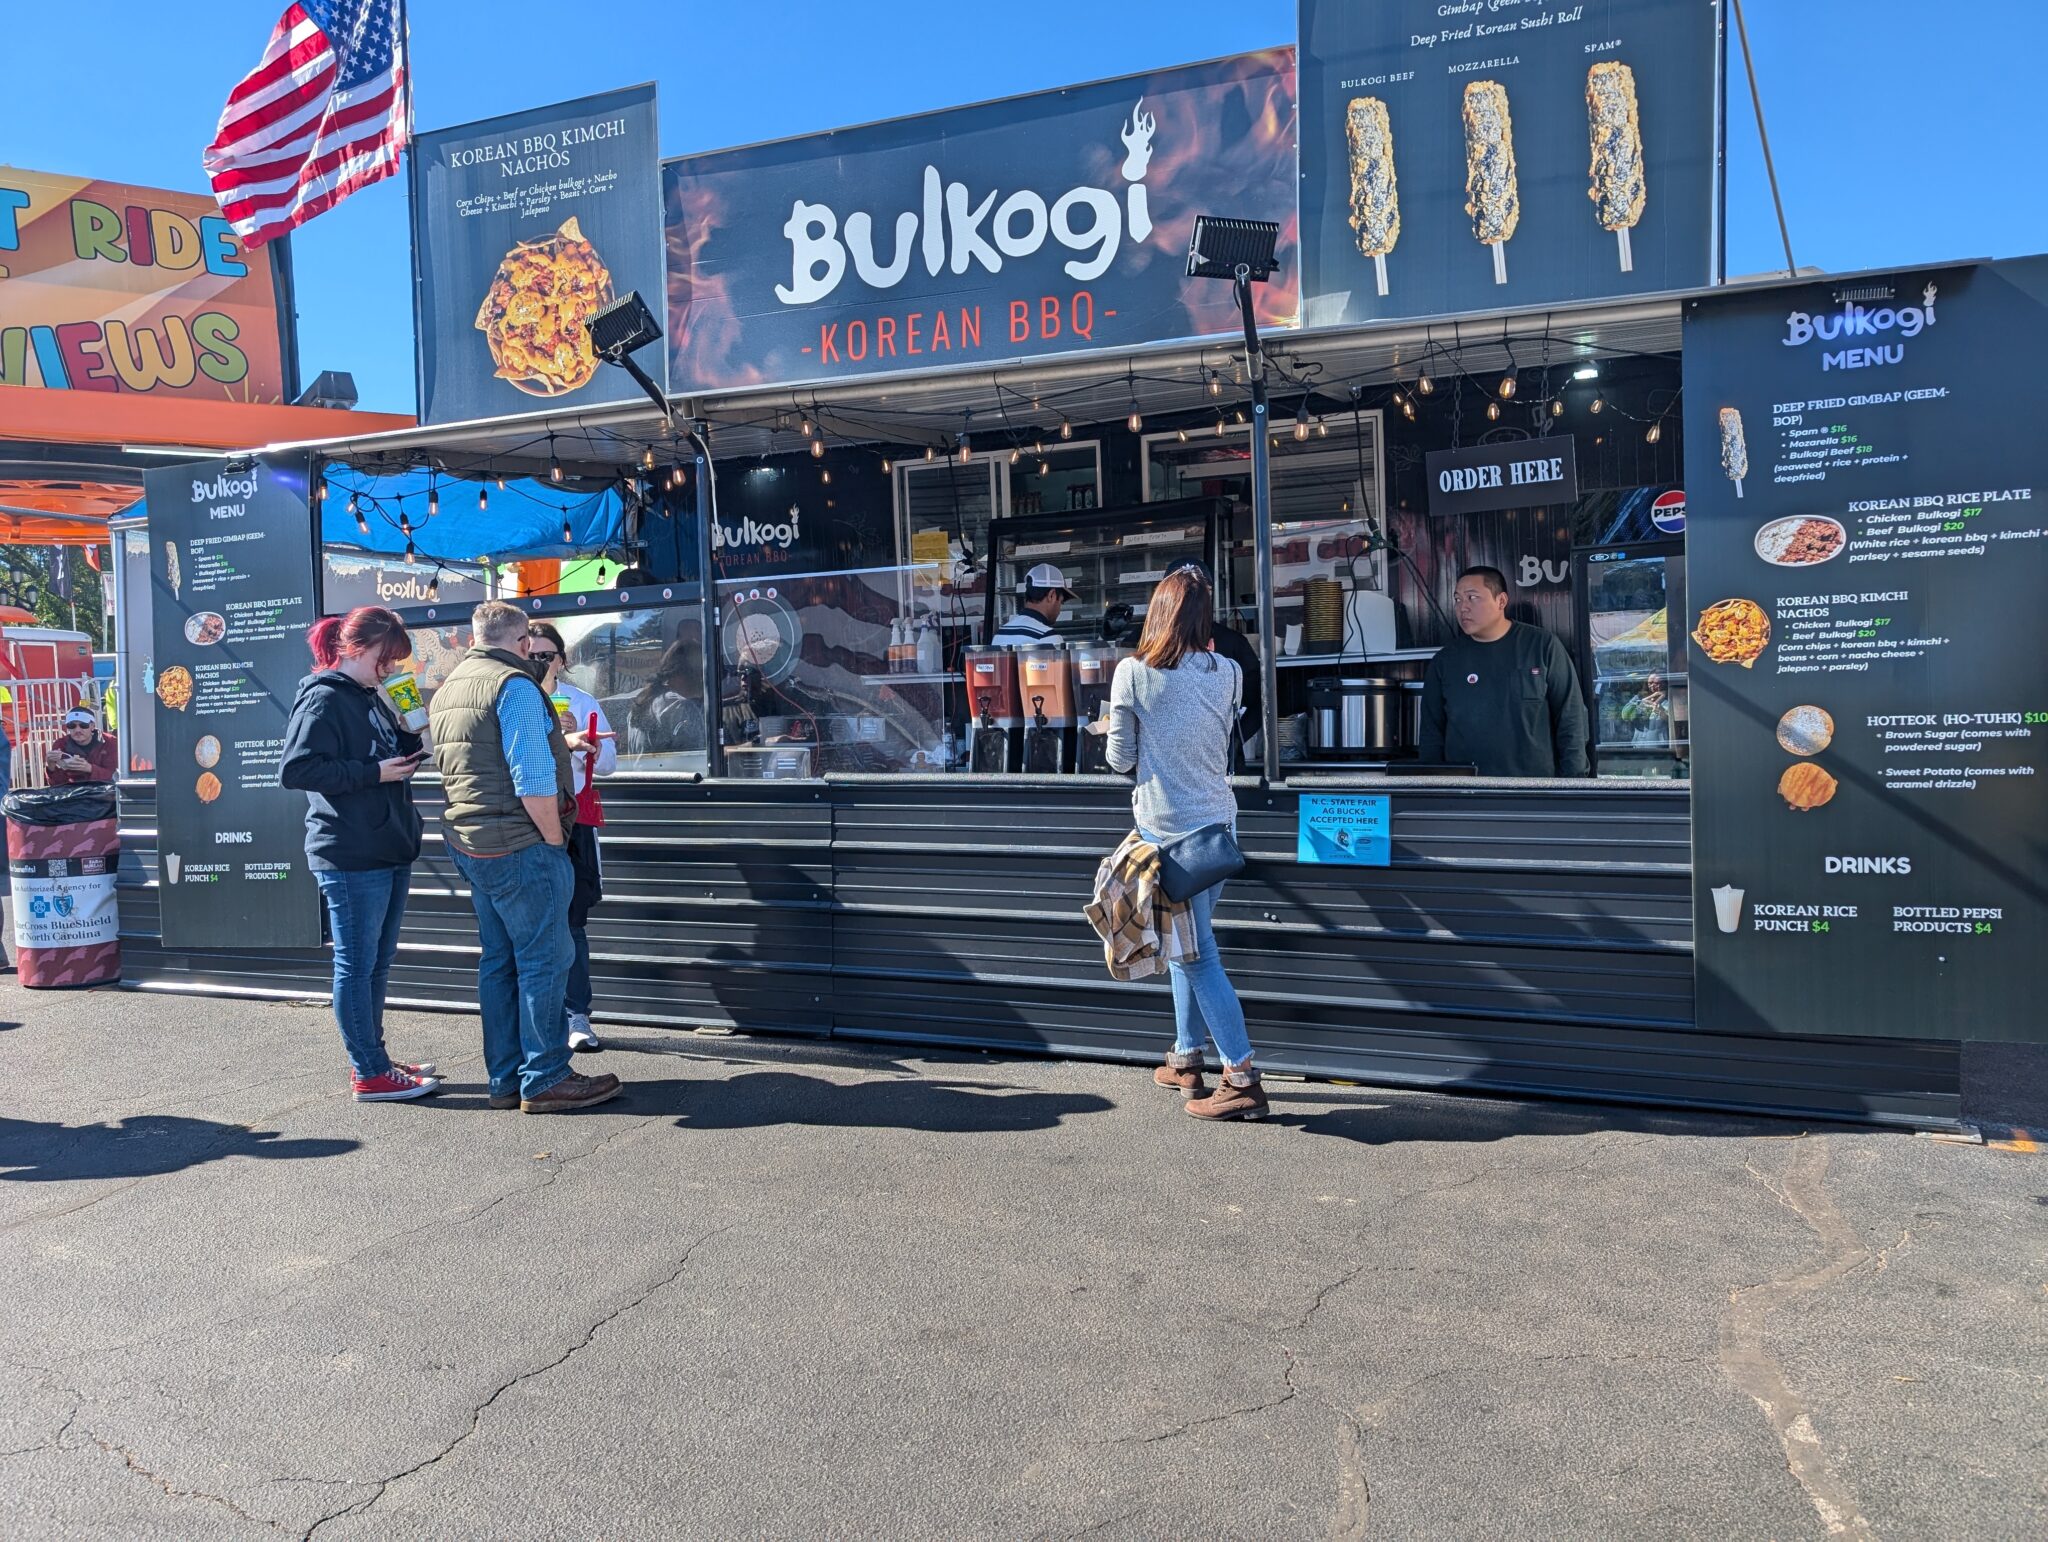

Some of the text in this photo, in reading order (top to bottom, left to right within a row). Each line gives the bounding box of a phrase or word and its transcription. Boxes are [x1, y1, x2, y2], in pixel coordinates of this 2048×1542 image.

[1437, 1, 1484, 17] Gimbap
[1410, 32, 1438, 49] Deep
[1440, 24, 1474, 42] Fried
[1475, 21, 1518, 37] Korean
[1520, 12, 1554, 30] Sushi
[1557, 5, 1584, 24] Roll
[1448, 56, 1520, 74] MOZZARELLA
[1341, 71, 1415, 89] BULKOGI BEEF
[451, 119, 626, 168] KOREAN BBQ KIMCHI
[501, 151, 571, 178] NACHOS
[455, 199, 473, 209] Corn
[474, 193, 495, 206] Chips
[503, 187, 519, 201] Beef
[519, 189, 527, 197] or
[528, 181, 557, 196] Chicken
[594, 169, 618, 183] Nacho
[460, 184, 607, 217] Cheese Kimchi Parsley Beans Corn
[773, 95, 1154, 305] Bulkogi
[70, 198, 249, 277] RIDE
[1782, 281, 1937, 347] Bulkogi
[1822, 343, 1905, 372] MENU
[1773, 387, 1951, 414] DEEP FRIED GIMBAP (GEEM-
[1773, 414, 1803, 427] BOP)
[1789, 424, 1848, 438] Spam $16
[1789, 435, 1858, 449] Mozarella $16
[1789, 445, 1873, 460] Bulkogi Beef $18
[1774, 454, 1900, 474] (seaweed rice protein
[1439, 457, 1564, 493] ORDER HERE
[1774, 471, 1826, 483] deepfried)
[191, 469, 259, 503] Bulkogi
[1848, 488, 2031, 512] KOREAN BBQ RICE PLATE
[209, 503, 246, 520] MENU
[1866, 508, 1983, 524] Chicken Bulkogi $17
[1866, 521, 1965, 536] Beef Bulkogi $20
[190, 538, 205, 547] DEEP
[205, 536, 222, 545] FRIED
[222, 533, 246, 543] GIMBAP
[1849, 529, 2041, 551] (White rice korean bbq kimchi
[1901, 548, 1946, 559] sesame
[1947, 545, 1985, 557] seeds)
[225, 596, 303, 611] KOREAN BBQ RICE PLATE
[1776, 590, 1909, 607] KOREAN BBQ KIMCHI
[1777, 607, 1830, 619] NACHOS
[1792, 618, 1892, 630] Chicken Bulkogi $17
[1792, 629, 1877, 640] Beef Bulkogi $20
[1777, 637, 1942, 653] (Corn chips korean bbq kimchi
[1777, 649, 1917, 662] beans corn nacho cheese
[195, 661, 254, 672] KOREAN BBQ KIMCHI
[1776, 662, 1869, 675] jalepeno parsley)
[195, 671, 220, 680] NACHOS
[1866, 711, 2048, 727] HOTTEOK (HO-TUHK) $10
[1885, 728, 2032, 740] Brown Sugar (comes with
[234, 740, 265, 749] HOTTEOK
[1884, 741, 1982, 753] powdered sugar)
[1885, 766, 2035, 778] Sweet Potato (comes with
[1886, 779, 1977, 790] caramel drizzle)
[1330, 798, 1356, 807] STATE
[1357, 799, 1377, 807] FAIR
[1322, 807, 1335, 815] AG
[1310, 816, 1379, 825] ACCEPTED HERE
[215, 831, 254, 844] DRINKS
[184, 863, 231, 873] KOREAN RICE
[244, 862, 292, 871] BOTTLED PEPSI
[1824, 856, 1912, 875] DRINKS
[184, 873, 219, 883] PUNCH $4
[244, 872, 279, 880] PRODUCTS
[56, 882, 88, 894] Agency
[88, 882, 102, 890] for
[1753, 904, 1858, 918] KOREAN RICE
[1893, 906, 2003, 919] BOTTLED PEPSI
[50, 915, 112, 930] BlueShield
[1753, 919, 1831, 934] PUNCH $4
[1893, 921, 1993, 934] PRODUCTS $4
[25, 932, 51, 942] North
[52, 930, 101, 941] Carolina
